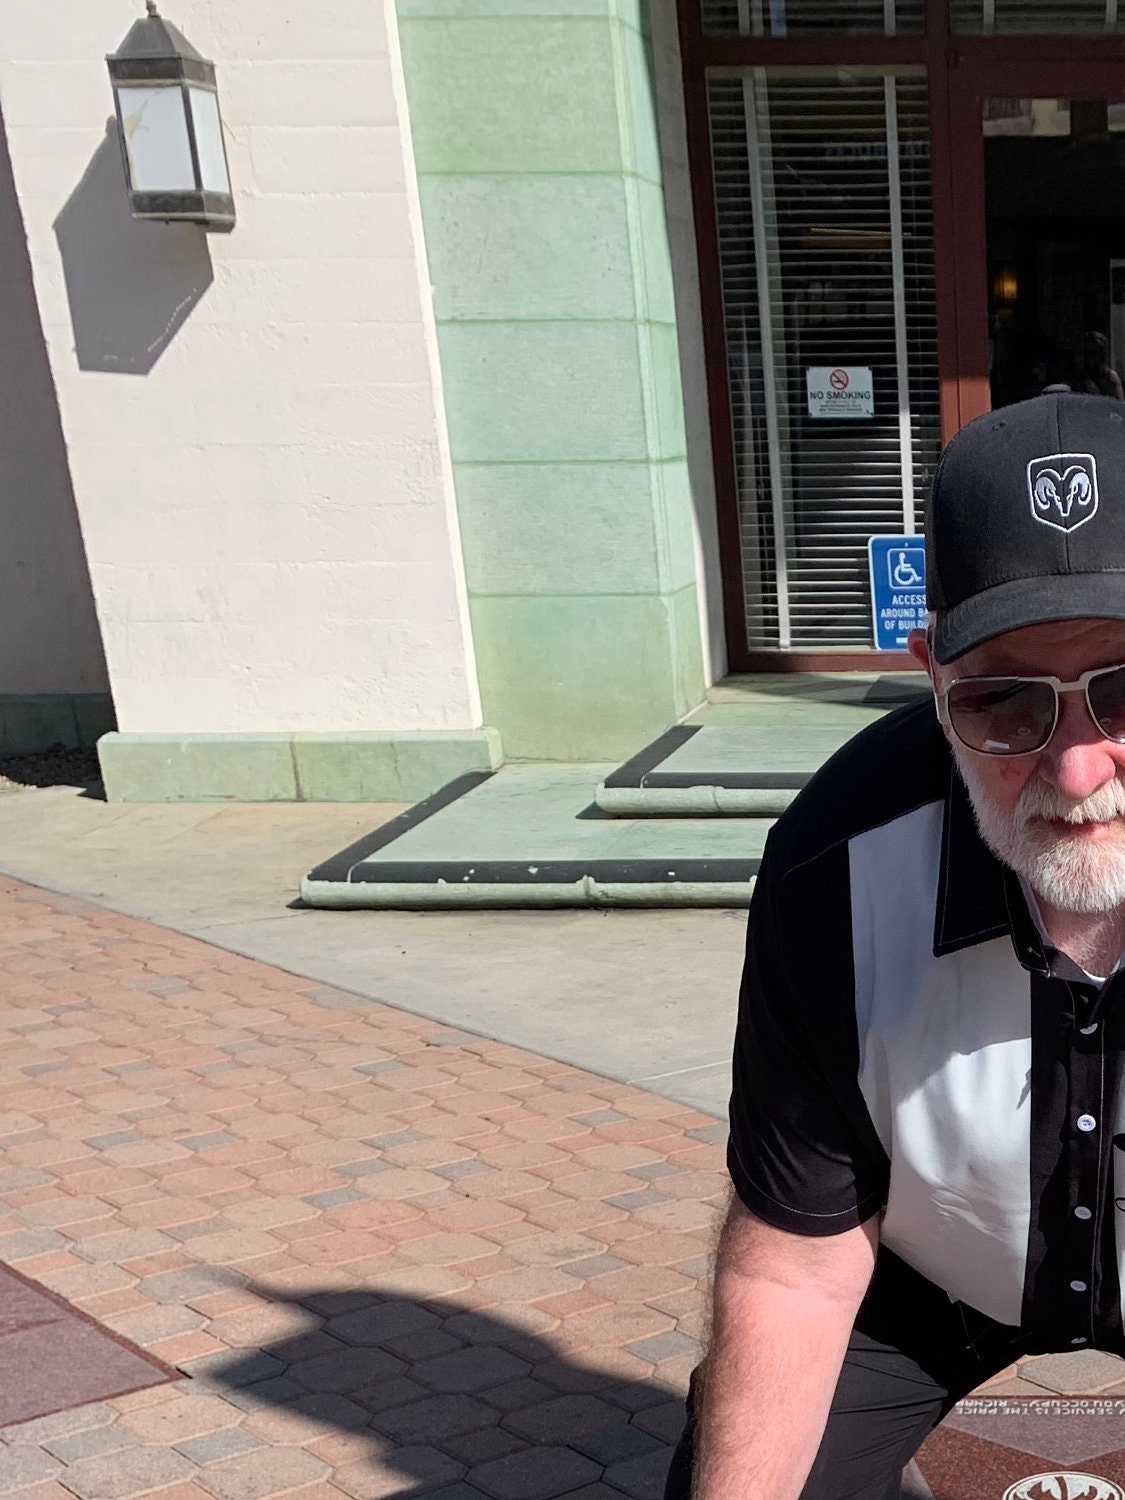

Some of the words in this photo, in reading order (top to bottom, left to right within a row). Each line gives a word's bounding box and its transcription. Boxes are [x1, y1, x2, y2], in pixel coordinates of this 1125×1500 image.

[810, 390, 824, 400] NO
[826, 390, 871, 400] SMOKING
[892, 594, 926, 605] ACCESS
[880, 607, 916, 618] AROUND
[884, 620, 896, 630] OF
[1093, 1400, 1125, 1408] YOU
[955, 1407, 998, 1415] PRICE
[1004, 1407, 1030, 1415] THE
[1035, 1407, 1049, 1415] IS
[1054, 1407, 1113, 1415] SERVICE
